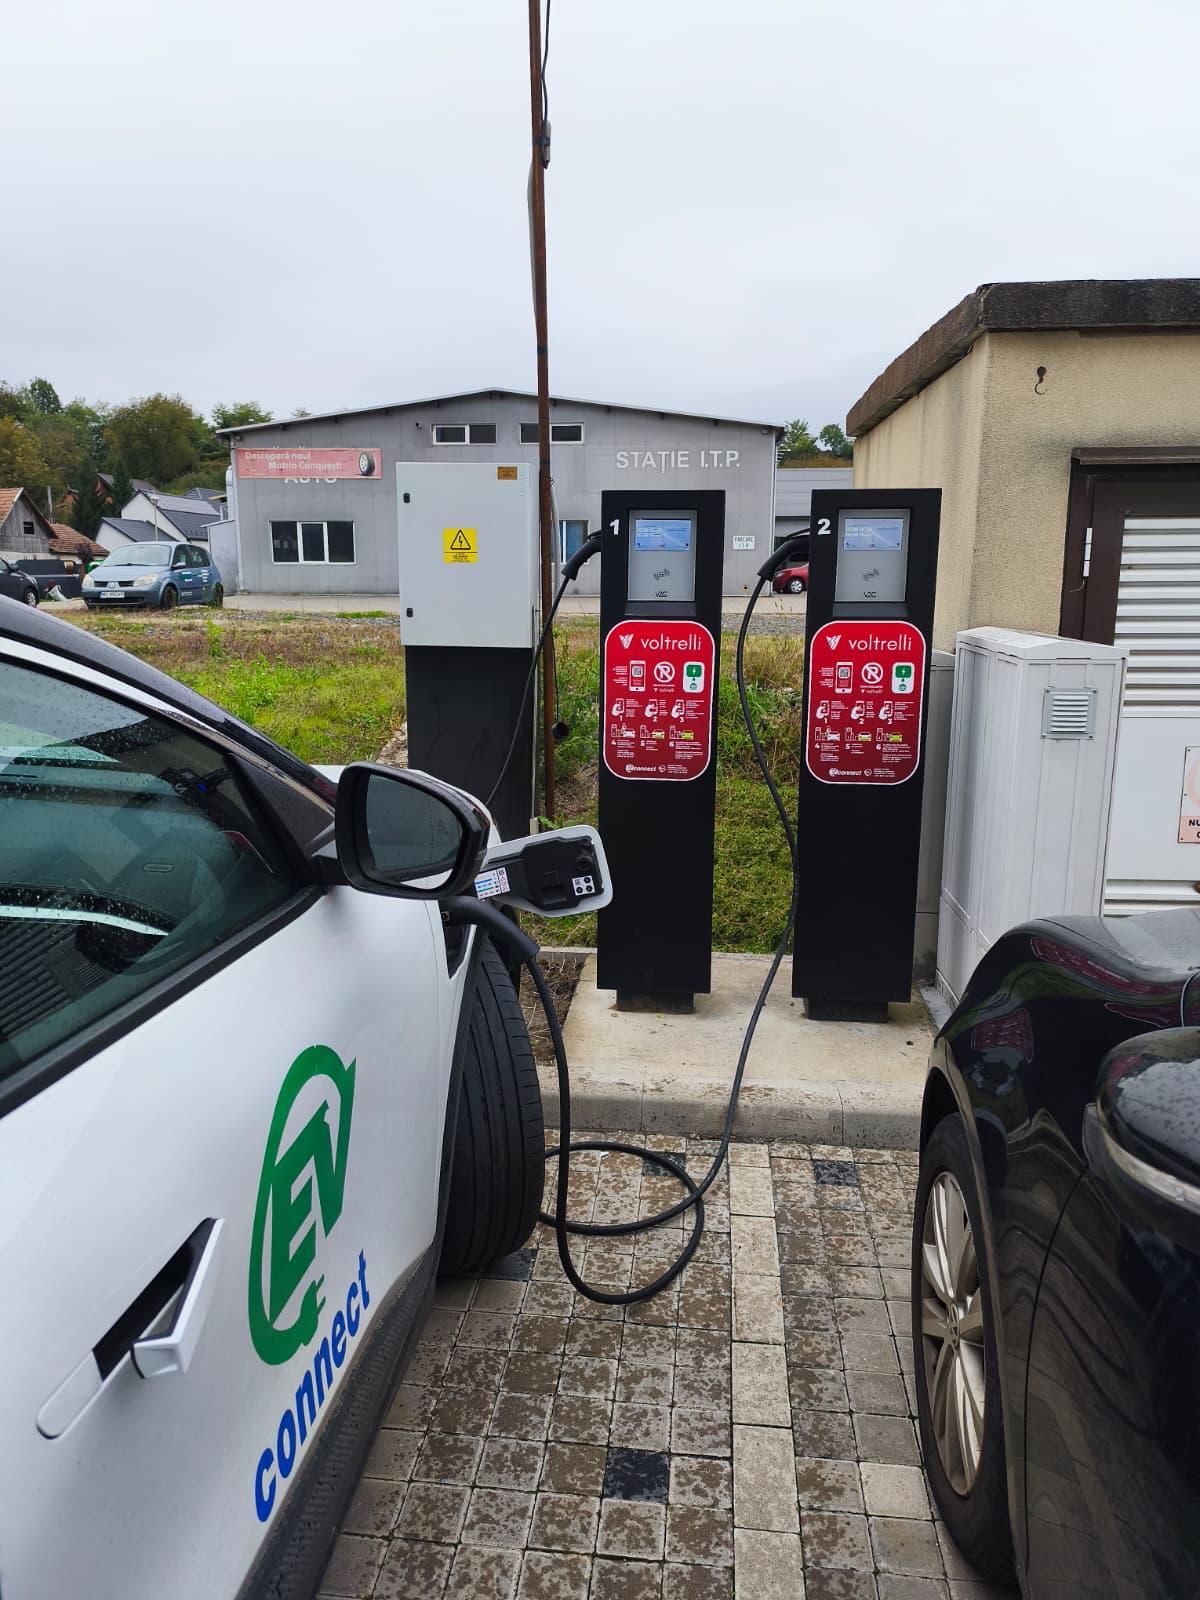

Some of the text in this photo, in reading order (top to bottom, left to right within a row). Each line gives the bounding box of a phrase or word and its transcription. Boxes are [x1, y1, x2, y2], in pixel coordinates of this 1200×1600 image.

[700, 450, 740, 468] I.T.P.
[609, 519, 620, 535] 1
[817, 518, 831, 535] 2
[640, 633, 701, 650] voltrelli
[848, 634, 912, 651] voltrelli
[254, 1248, 371, 1523] connect
